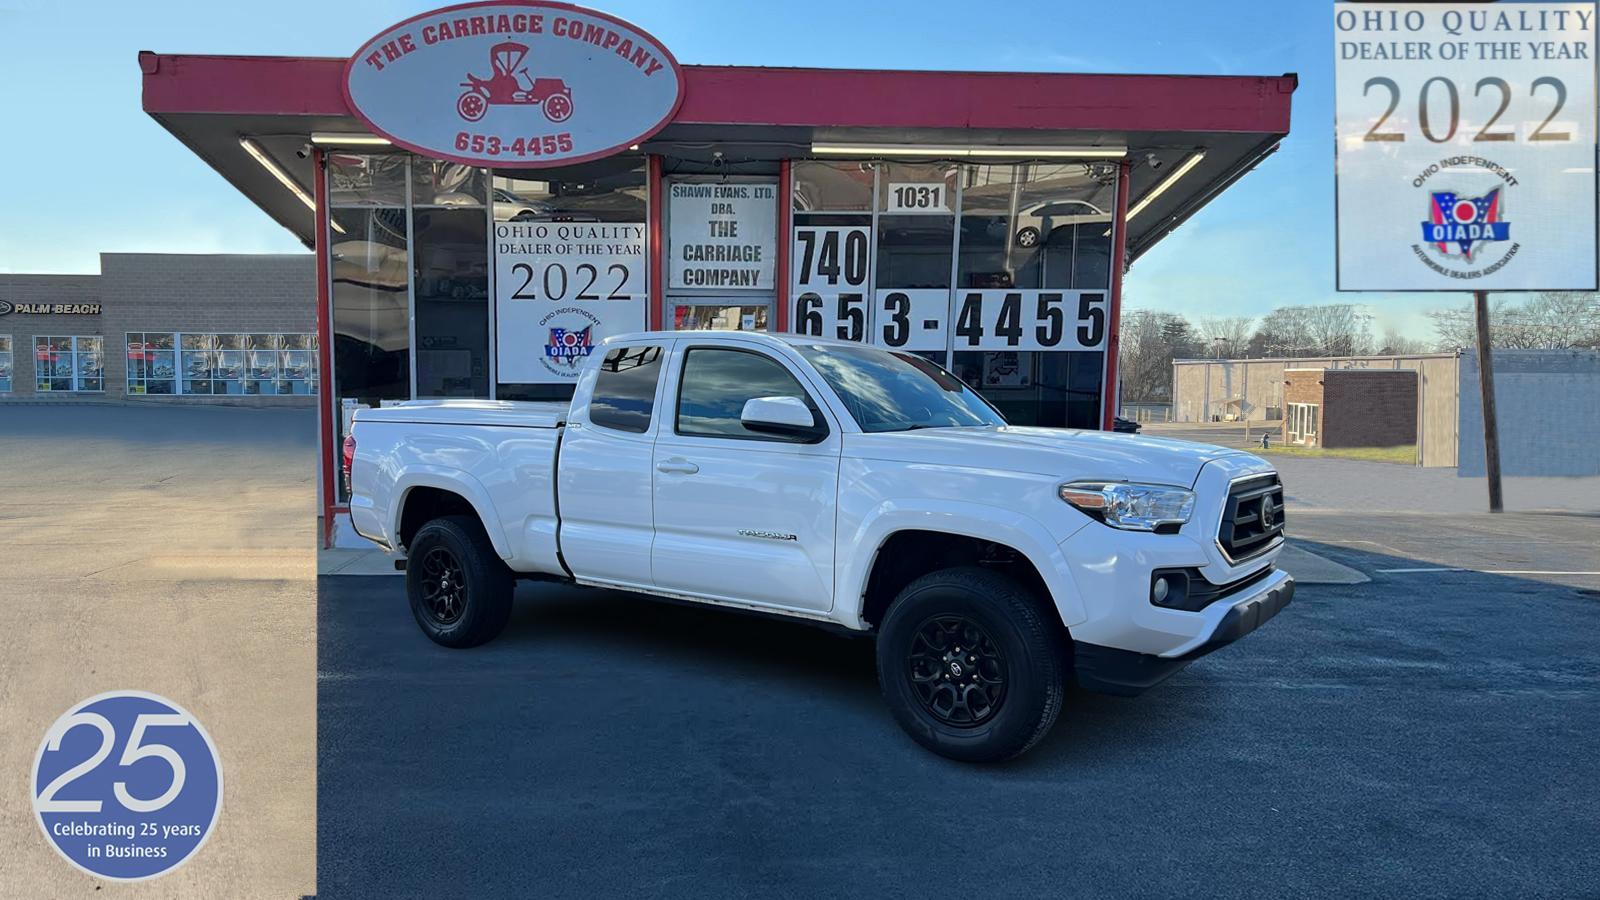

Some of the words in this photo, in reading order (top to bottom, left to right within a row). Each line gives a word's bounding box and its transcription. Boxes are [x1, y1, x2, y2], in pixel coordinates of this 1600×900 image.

[1336, 10, 1425, 31] OHIO
[1442, 10, 1593, 35] QUALITY
[366, 33, 416, 71] THE
[422, 14, 543, 45] CARRIAGE
[552, 17, 664, 77] COMPANY
[1340, 42, 1433, 60] DEALER
[1439, 42, 1469, 60] OF
[1475, 42, 1522, 60] THE
[1528, 42, 1589, 60] YEAR
[1363, 76, 1570, 143] 2022
[454, 132, 573, 156] 653-4455
[1412, 164, 1439, 188] OHIO
[1440, 156, 1519, 187] INDEPENDENT
[673, 186, 712, 199] SHAWN
[754, 187, 775, 199] LTD.
[894, 187, 940, 208] 1031
[711, 203, 736, 215] DBA.
[497, 226, 548, 239] OHIO
[558, 226, 644, 240] QUALITY
[709, 220, 738, 237] THE
[1432, 225, 1495, 240] OIADA
[500, 244, 552, 254] DEALER
[555, 244, 574, 255] OF
[576, 244, 603, 255] THE
[607, 245, 641, 255] YEAR
[683, 244, 762, 262] CARRIAGE
[797, 230, 868, 286] 740
[511, 263, 631, 300] 2022
[683, 268, 760, 286] COMPANY
[1450, 270, 1482, 280] DEALERS
[15, 304, 51, 314] PALM
[54, 304, 100, 314] BEACH
[539, 312, 555, 326] OHIO
[555, 307, 600, 326] INDEPENDENT
[551, 346, 587, 356] OIADA
